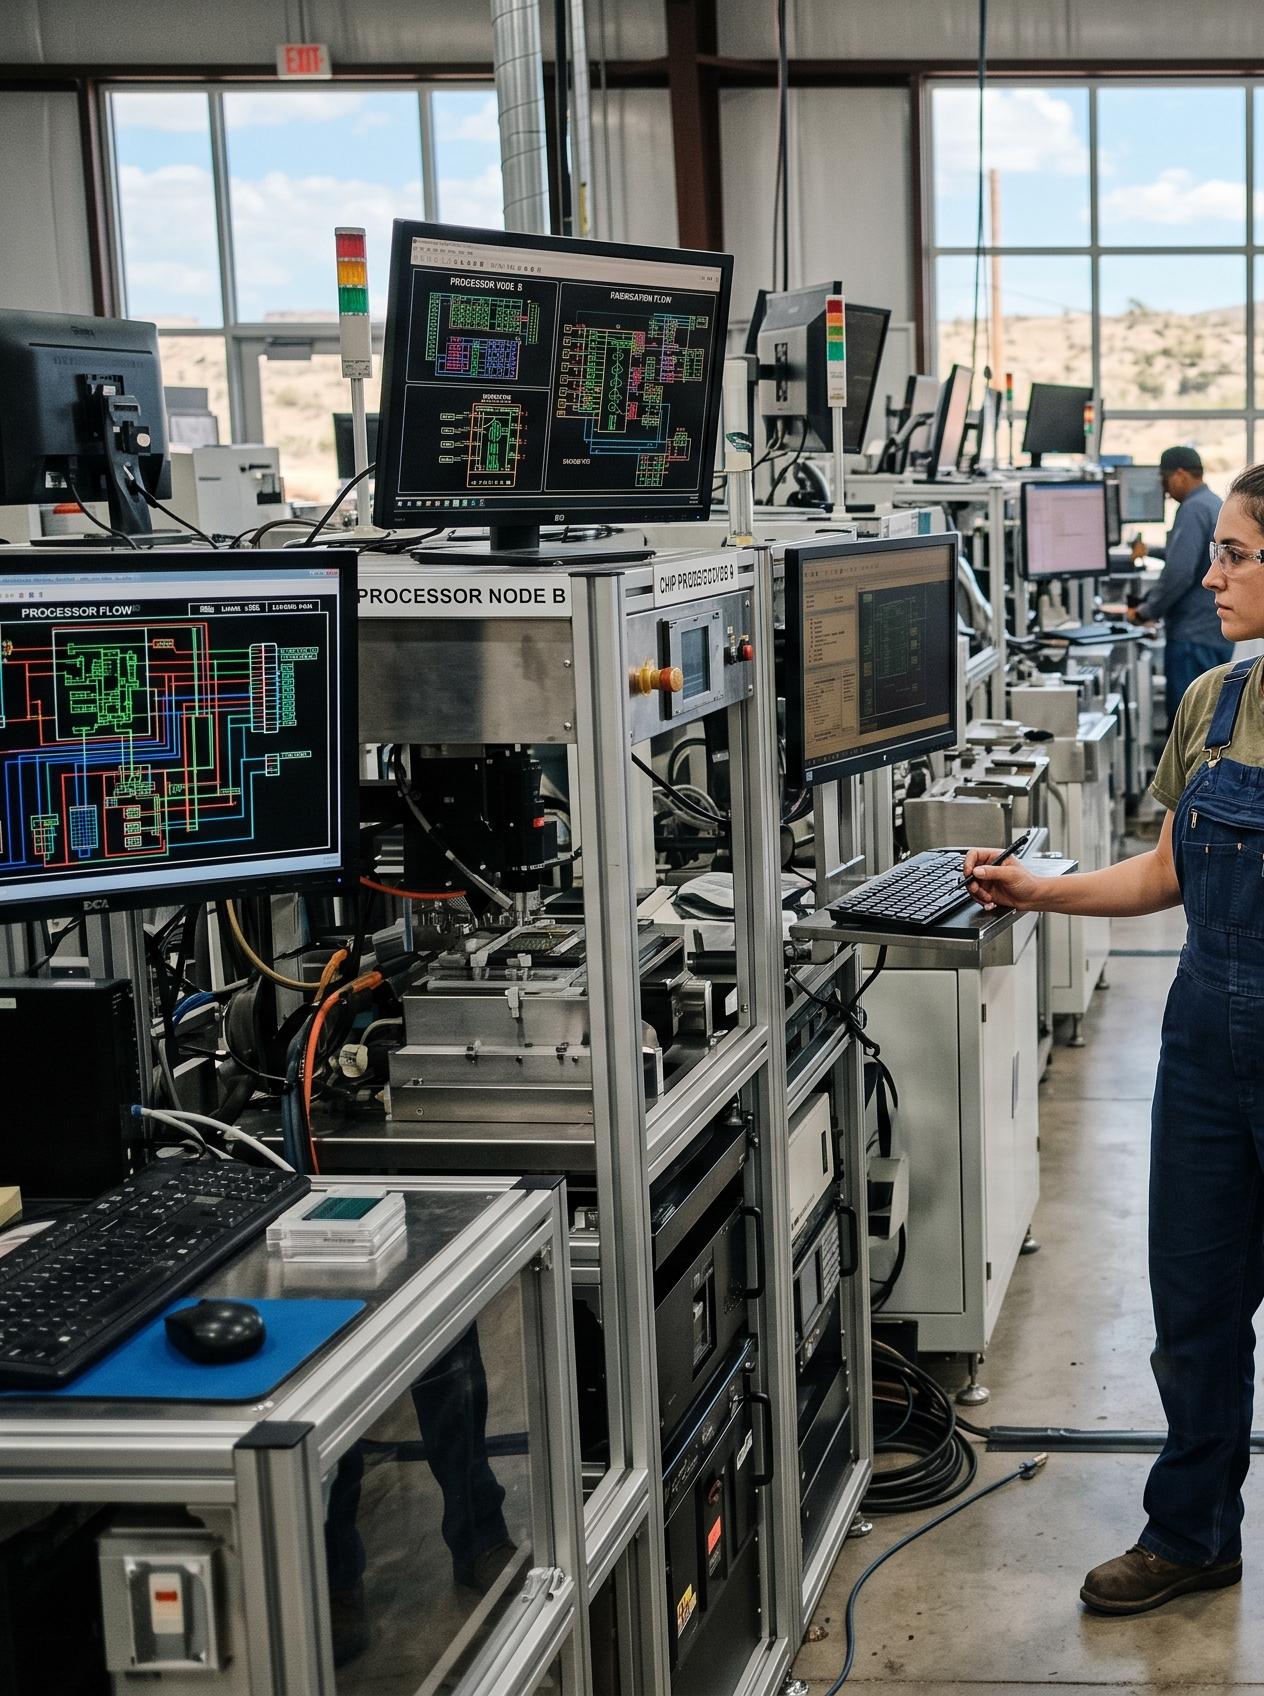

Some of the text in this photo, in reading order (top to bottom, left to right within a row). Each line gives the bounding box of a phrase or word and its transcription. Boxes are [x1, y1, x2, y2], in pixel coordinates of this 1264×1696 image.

[450, 277, 495, 289] PROCESSOR
[660, 574, 676, 594] CHIP
[357, 588, 566, 604] PROCESSOR NODE B
[21, 607, 97, 618] PROCESSOR
[99, 605, 132, 616] FLOW
